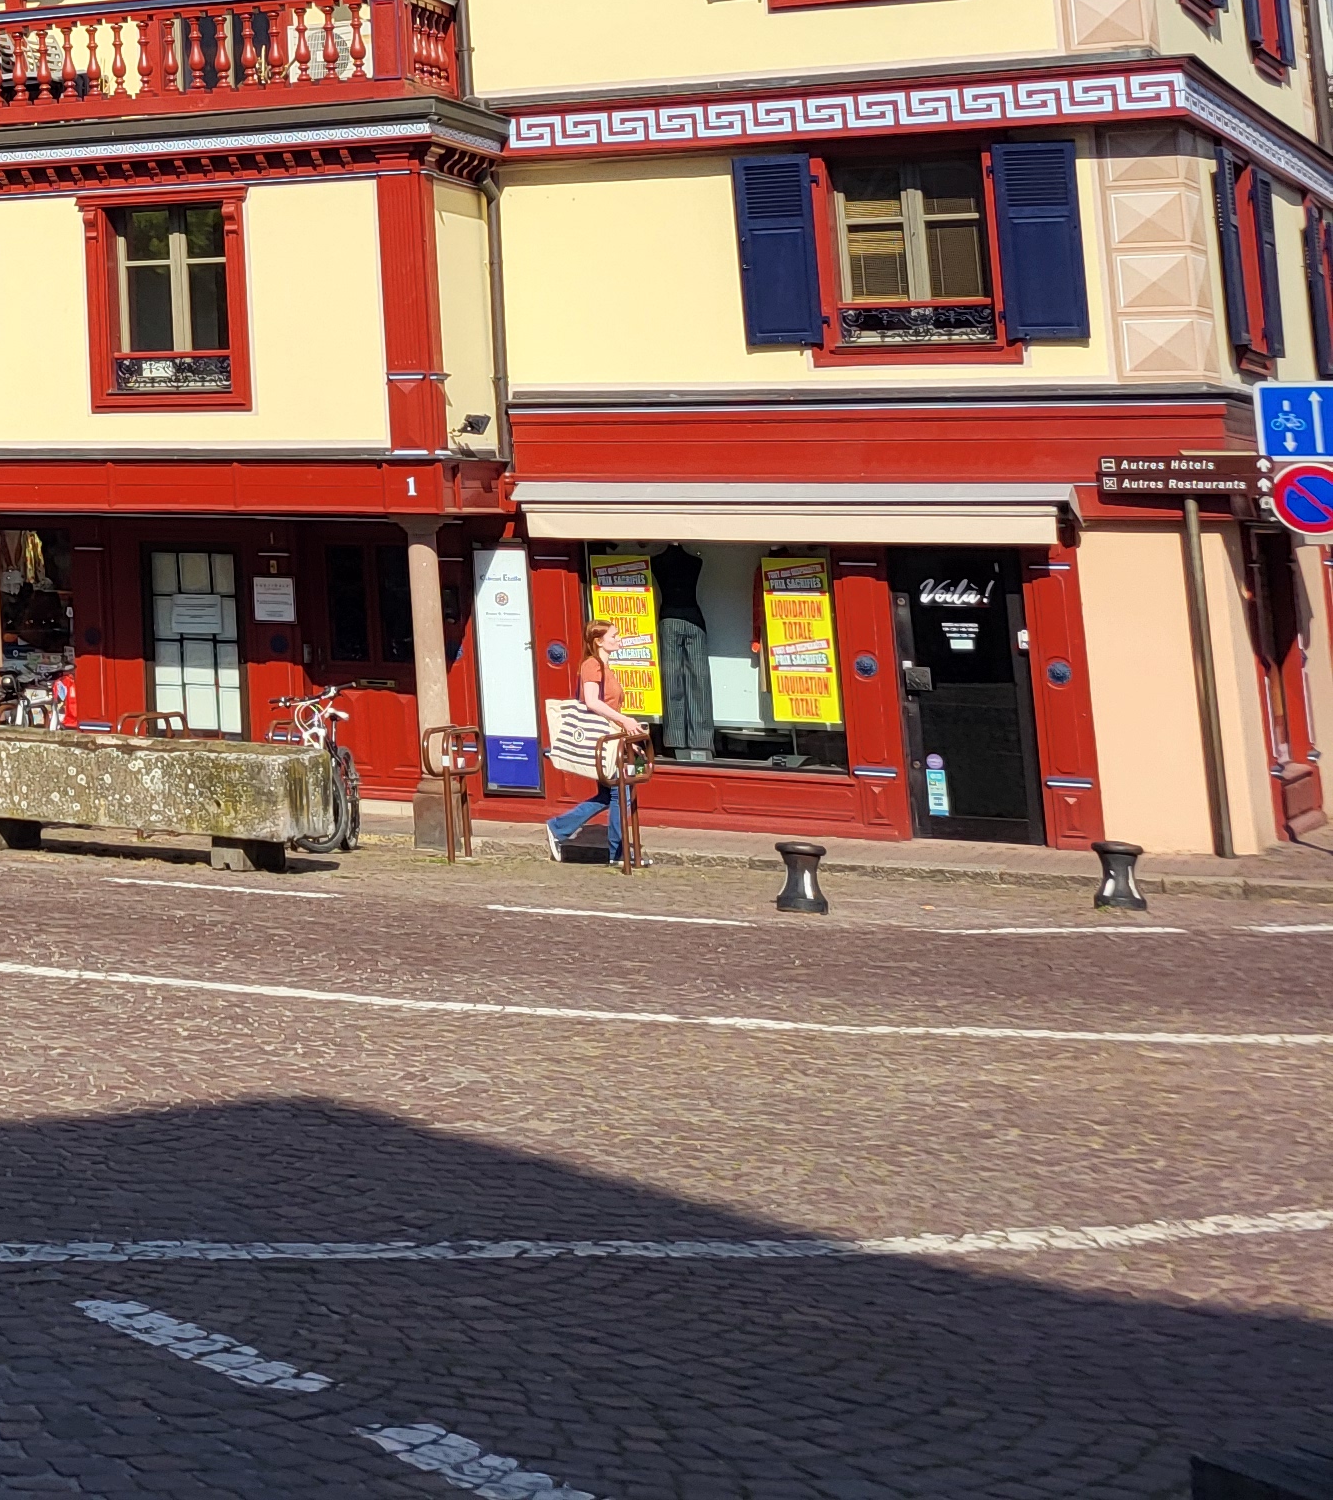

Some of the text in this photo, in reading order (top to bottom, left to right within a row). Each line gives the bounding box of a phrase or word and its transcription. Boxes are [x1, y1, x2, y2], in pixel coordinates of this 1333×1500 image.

[1120, 459, 1214, 470] Autres Hôtels
[406, 476, 418, 496] 1
[1122, 479, 1246, 490] Autres Restaurants
[598, 595, 648, 616] LIQUIDATION
[770, 599, 824, 620] LIQUIDATION
[782, 621, 813, 640] TOTALE
[776, 674, 830, 696] LIQUIDATION
[789, 697, 820, 718] TOTALE
